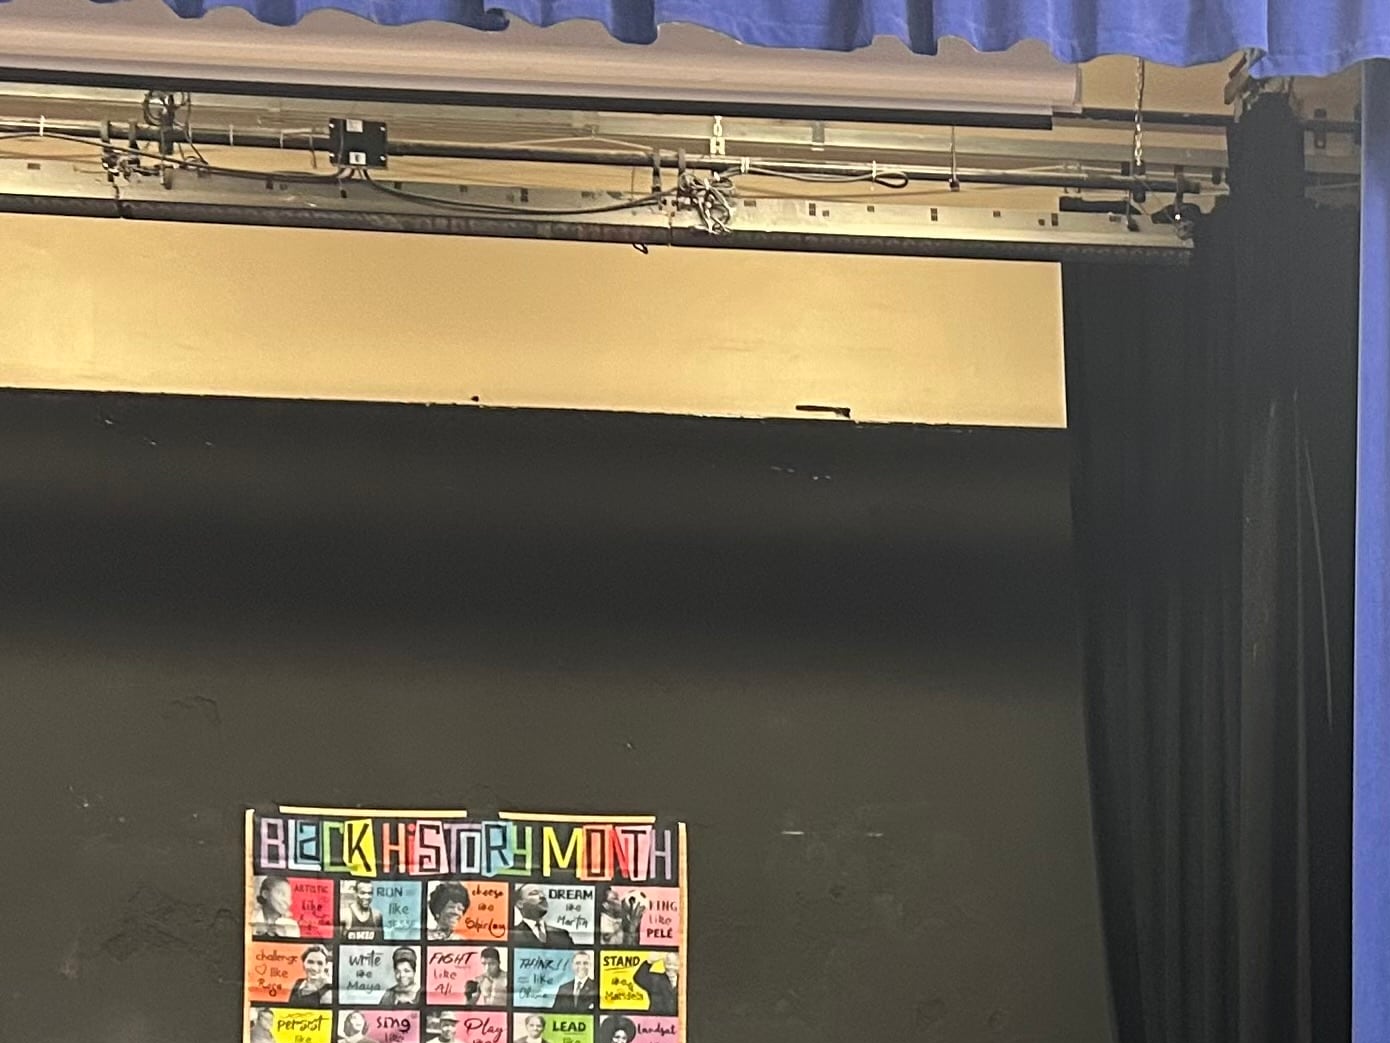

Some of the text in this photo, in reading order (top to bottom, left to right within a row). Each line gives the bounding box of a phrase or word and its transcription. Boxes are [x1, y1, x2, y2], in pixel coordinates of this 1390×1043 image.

[543, 824, 672, 880] MONTH
[376, 886, 403, 897] RUN
[549, 889, 593, 900] DREAM
[388, 903, 409, 915] like
[429, 951, 478, 965] FIGHT
[603, 956, 640, 967] STAND
[269, 968, 288, 978] like
[464, 1017, 504, 1043] Play
[552, 1020, 586, 1032] LEAD
